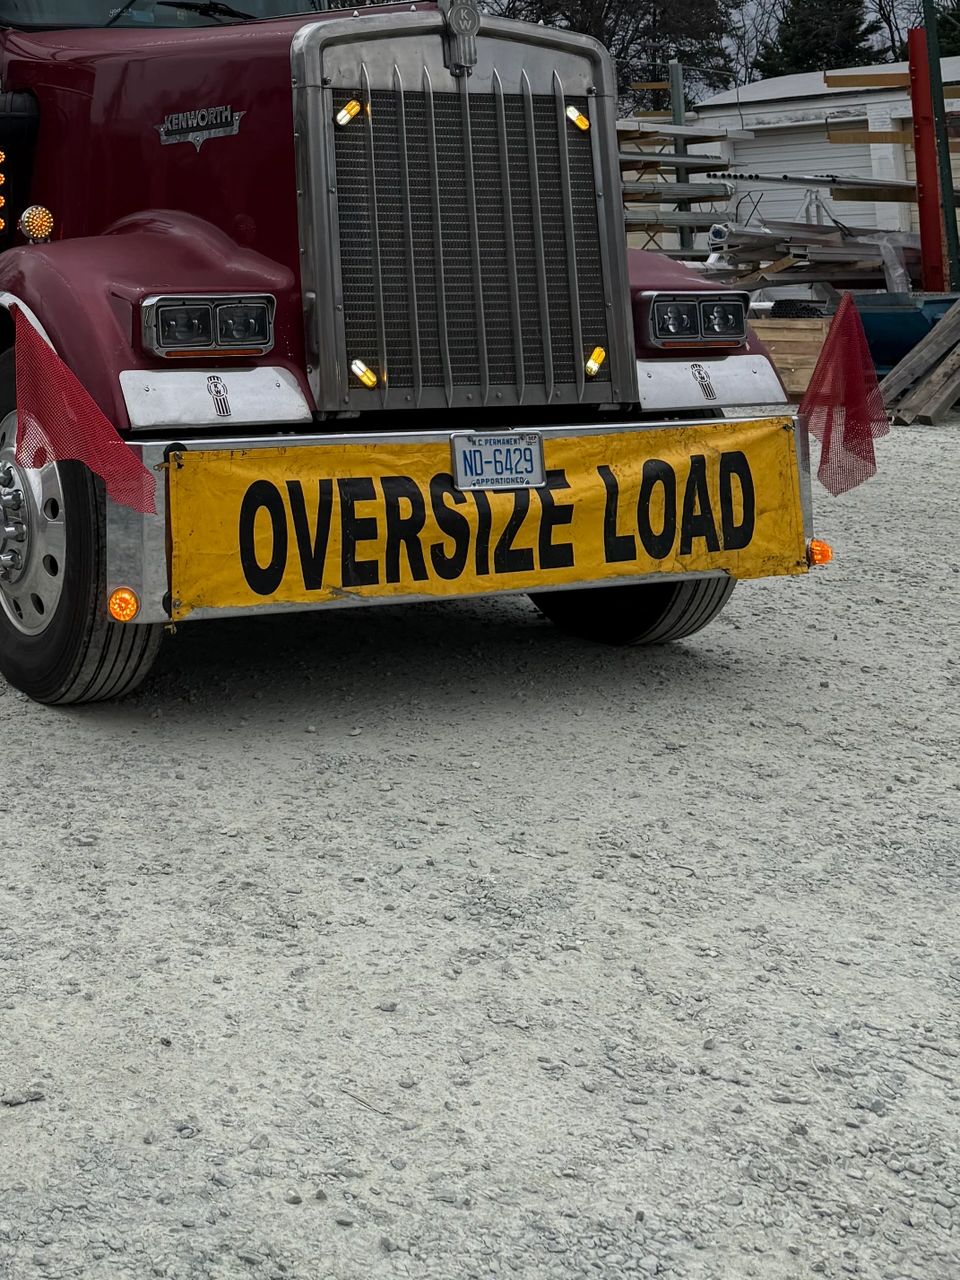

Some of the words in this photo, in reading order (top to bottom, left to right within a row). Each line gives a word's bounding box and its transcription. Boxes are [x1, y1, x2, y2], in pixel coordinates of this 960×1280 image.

[164, 105, 232, 130] KENWORTH
[485, 437, 521, 446] PERMANENT
[462, 447, 534, 477] ND-6429
[476, 477, 524, 485] APPORTIONED
[239, 469, 575, 596] OVERSIZE
[596, 450, 756, 564] LOAD
